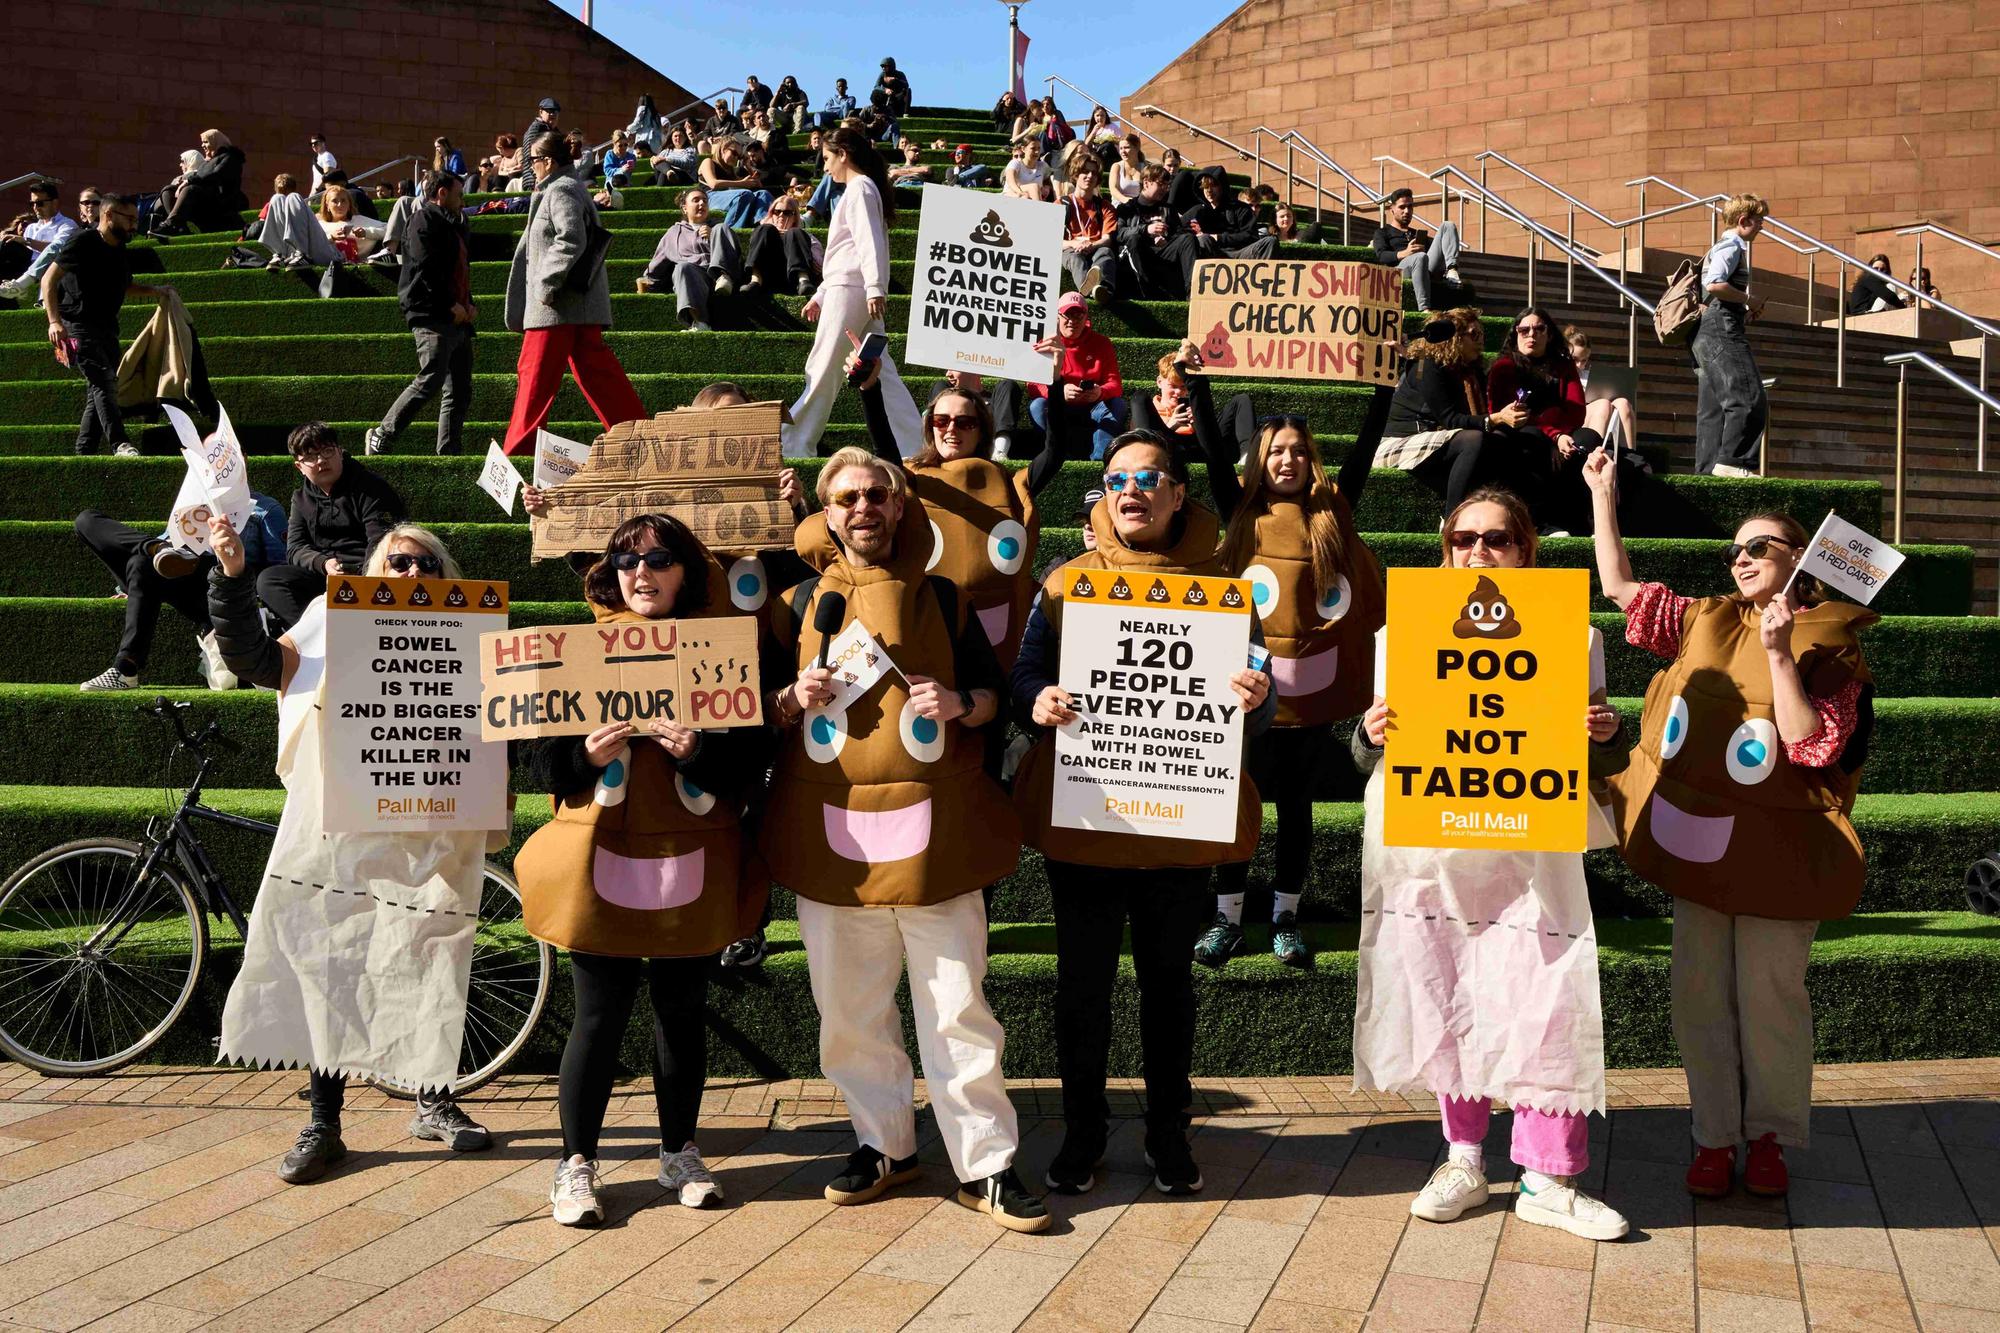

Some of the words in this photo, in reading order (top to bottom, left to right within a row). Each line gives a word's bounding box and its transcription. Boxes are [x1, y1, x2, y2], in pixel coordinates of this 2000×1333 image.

[930, 241, 1048, 278] #BOWEL
[928, 266, 1047, 302] CANCER
[1198, 263, 1306, 297] FORGET
[1308, 262, 1402, 303] SWIPING
[925, 289, 1046, 319] AWARENESS
[924, 305, 1045, 343] MONTH
[1229, 302, 1316, 335] CHECK
[1327, 304, 1399, 340] YOUR
[956, 351, 978, 363] Pall
[981, 355, 1005, 366] Mall
[553, 445, 570, 457] GIVE
[705, 430, 780, 471] LOVE
[1818, 537, 1849, 559] BOWEL
[1851, 555, 1887, 580] CANCER
[1848, 540, 1873, 558] GIVE
[1817, 550, 1826, 560] A
[1826, 554, 1847, 571] RED
[1846, 566, 1877, 588] CARD!
[440, 620, 463, 628] POO:
[1120, 620, 1191, 636] NEARLY
[379, 636, 456, 652] BOWEL
[495, 632, 567, 666] HEY
[1116, 638, 1194, 671] 120
[371, 659, 462, 674] CANCER
[1437, 649, 1538, 681] POO
[381, 681, 402, 696] IS
[409, 682, 453, 696] THE
[1090, 670, 1206, 697] PEOPLE
[341, 704, 386, 718] 2ND
[487, 690, 586, 728] CHECK
[596, 689, 675, 724] YOUR
[690, 686, 757, 722] POO
[1066, 693, 1165, 719] EVERY
[1175, 701, 1238, 724] DAY
[1469, 694, 1504, 718] IS
[370, 727, 461, 741] CANCER
[1079, 722, 1114, 735] ARE
[1120, 724, 1224, 744] DIAGNOSED
[1446, 729, 1527, 755] NOT
[361, 749, 440, 763] KILLER
[448, 749, 470, 763] IN
[1092, 740, 1136, 754] WITH
[1143, 744, 1205, 760] BOWEL
[370, 772, 415, 786] THE
[423, 772, 461, 786] UK!
[1060, 754, 1131, 771] CANCER
[1138, 761, 1156, 773] IN
[1162, 763, 1197, 776] THE
[1204, 766, 1234, 780] UK.
[1067, 775, 1224, 795] #BOWELCANCERAWARENESSMONTH
[1392, 766, 1579, 800] TABOO!
[377, 798, 412, 813] Pall
[417, 798, 455, 812] Mall
[1105, 798, 1139, 815] Pall
[1144, 801, 1184, 819] Mall
[1441, 811, 1479, 829] Pall
[1484, 812, 1528, 830] Mall
